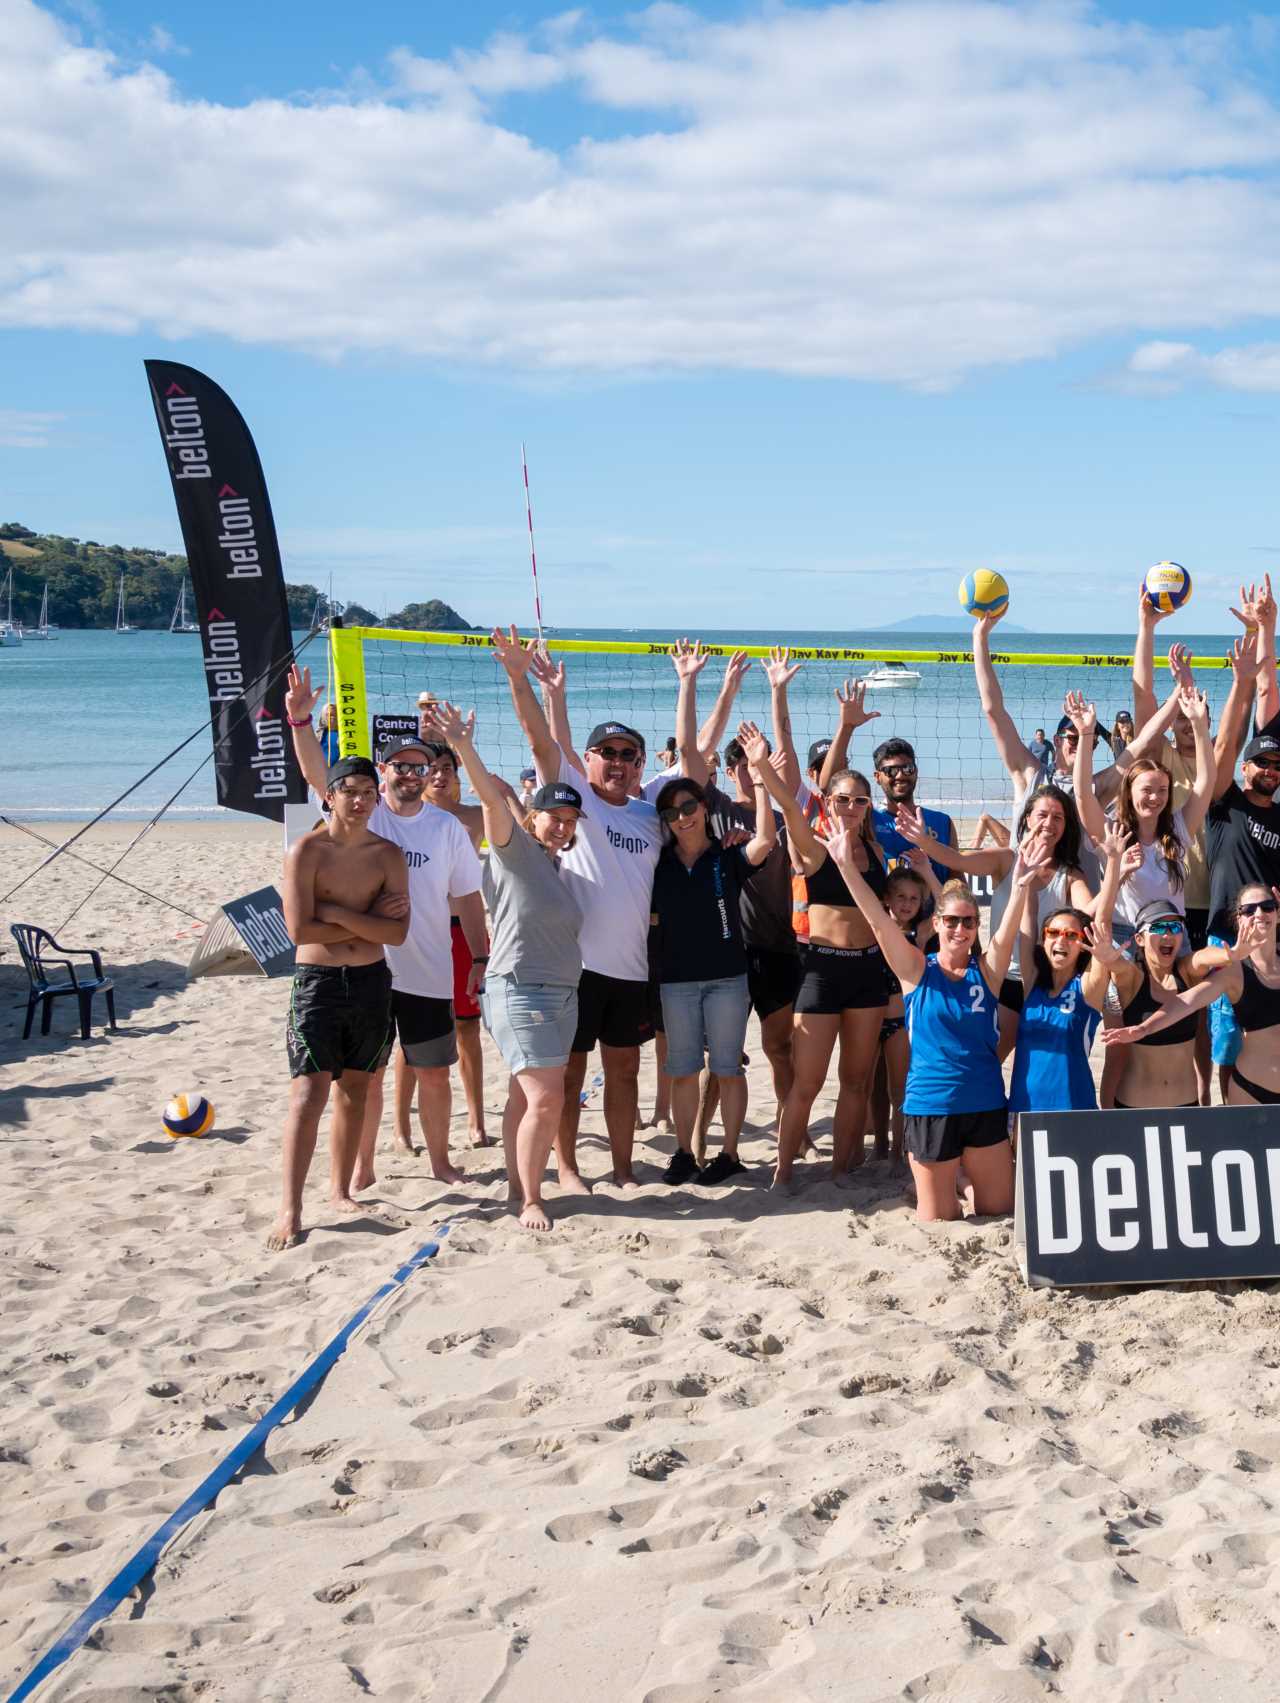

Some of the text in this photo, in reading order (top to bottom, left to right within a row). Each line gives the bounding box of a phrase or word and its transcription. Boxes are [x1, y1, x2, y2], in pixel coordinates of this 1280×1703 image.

[167, 396, 212, 480] belton
[218, 497, 262, 579] belton
[461, 635, 482, 647] Jay
[648, 644, 668, 655] Jay
[702, 646, 723, 656] Pro
[205, 619, 246, 703] belton
[791, 649, 865, 660] Jay Kay Pro
[938, 653, 957, 663] Jay
[990, 653, 1010, 664] Pro
[1082, 656, 1130, 667] Jay Kay
[340, 683, 359, 758] SPORTS
[375, 718, 417, 729] Centre
[251, 718, 288, 800] belton
[718, 898, 729, 939] Harcourts
[228, 903, 296, 963] belton
[969, 984, 985, 1013] 2
[1060, 990, 1076, 1014] 3
